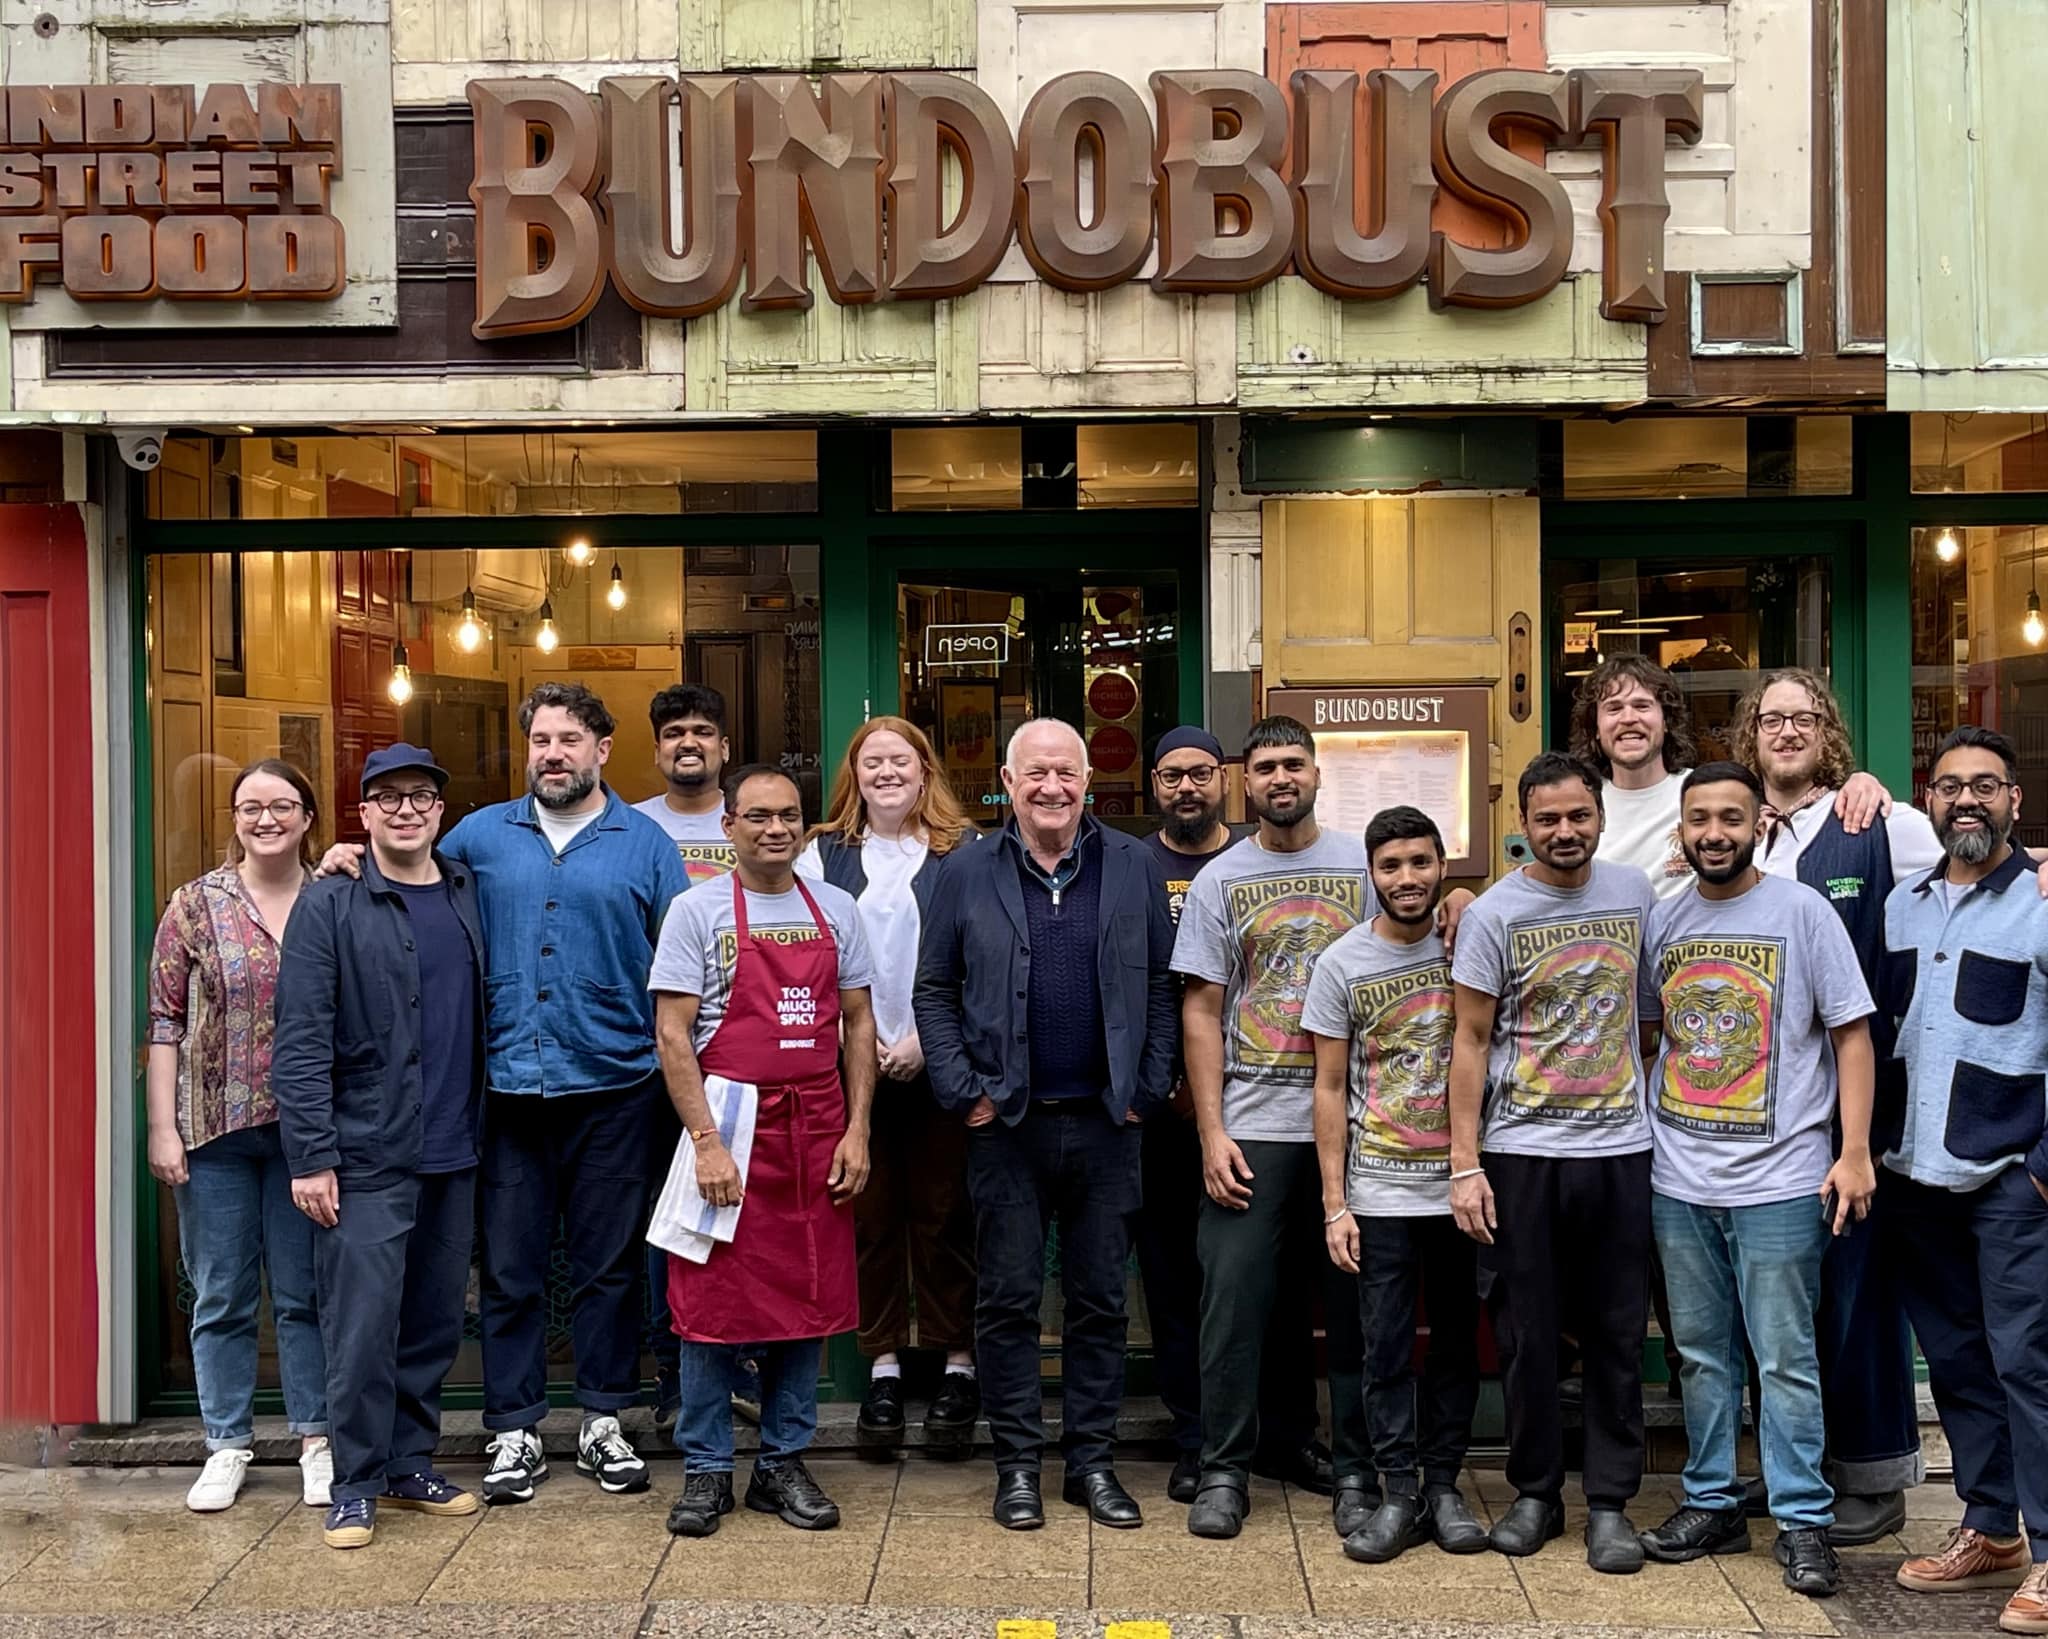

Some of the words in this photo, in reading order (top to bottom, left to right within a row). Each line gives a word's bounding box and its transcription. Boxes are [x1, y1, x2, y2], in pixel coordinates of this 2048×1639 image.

[0, 150, 337, 211] STREET
[467, 70, 1704, 340] BUNDOBUST
[0, 214, 344, 302] FOOD
[1314, 697, 1444, 725] BUNDOBUST
[1233, 878, 1358, 919] BUNDOBUST
[1516, 920, 1636, 966] BUNDOBUST
[1664, 943, 1774, 980] BUNDOBUST
[777, 999, 817, 1013] MUCH
[780, 986, 811, 999] TOO
[1729, 1124, 1762, 1133] FOOD
[1359, 1155, 1408, 1171] INDIAN
